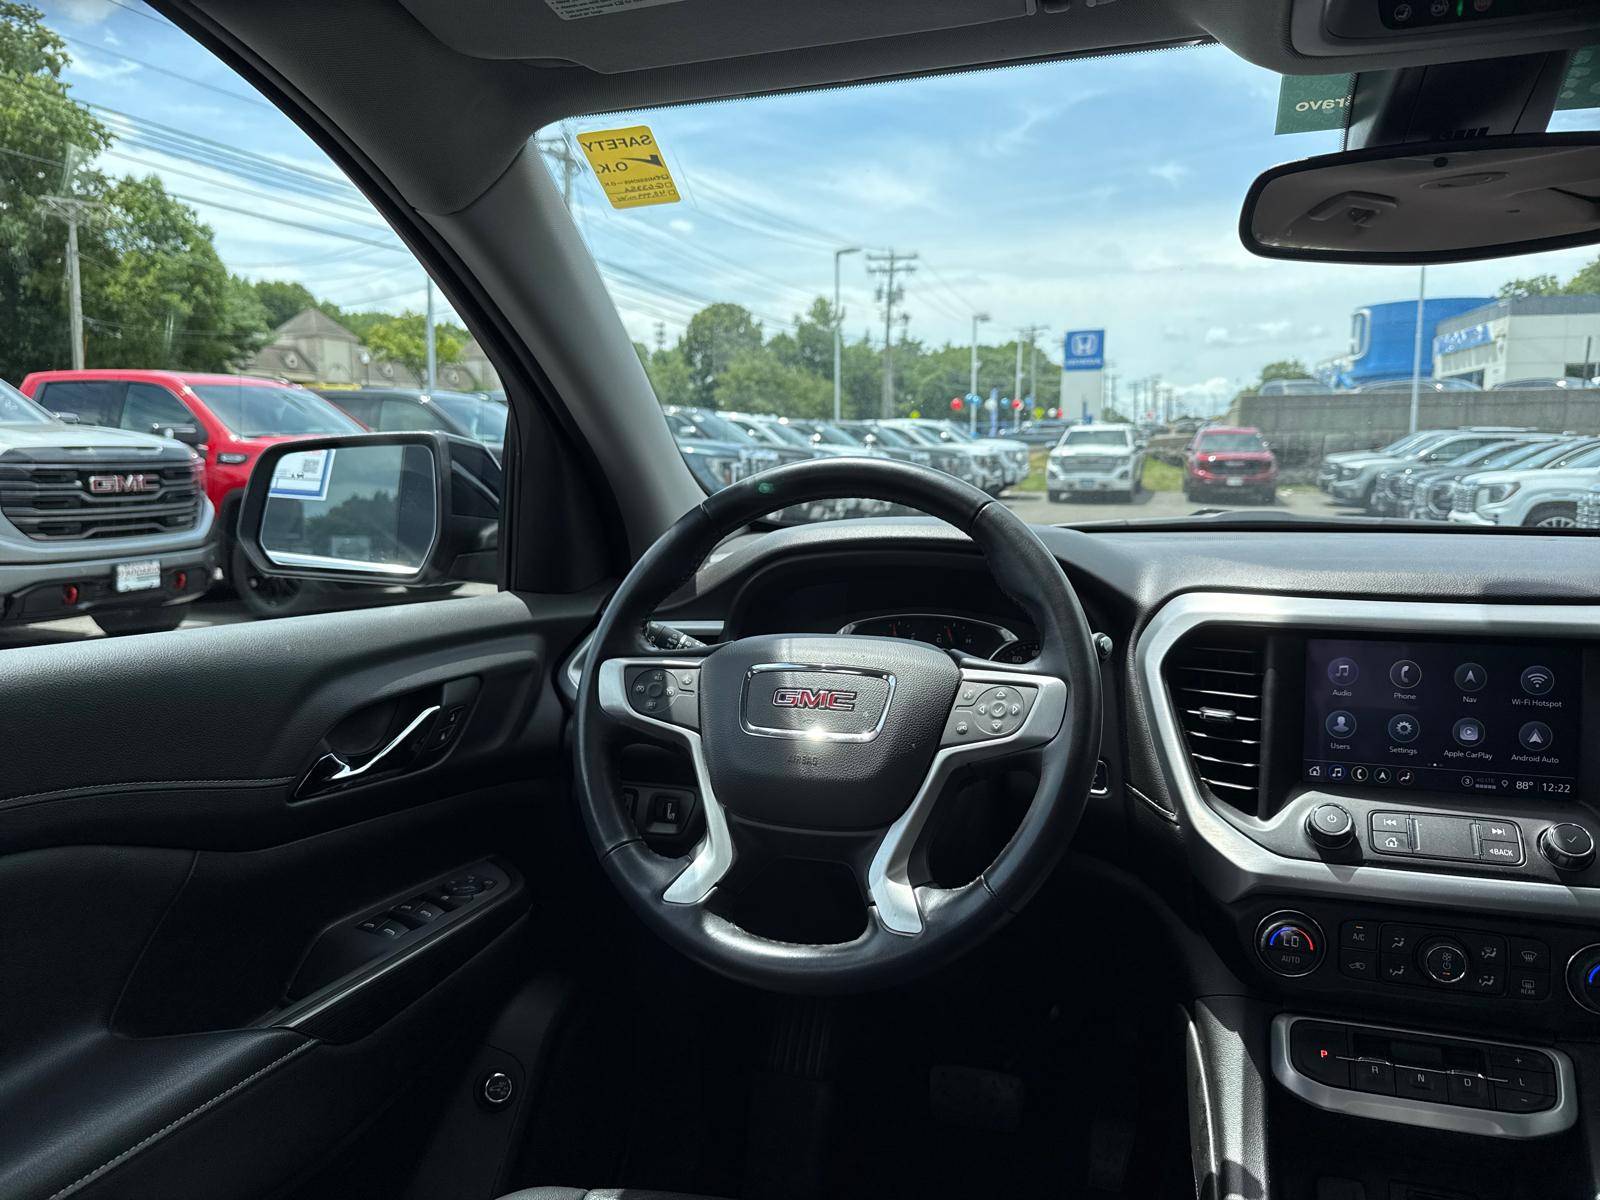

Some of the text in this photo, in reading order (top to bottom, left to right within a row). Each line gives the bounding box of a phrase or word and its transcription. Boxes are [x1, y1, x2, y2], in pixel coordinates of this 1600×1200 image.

[89, 474, 160, 493] GMC
[773, 688, 857, 711] GMC
[1393, 692, 1417, 700] Phone
[1511, 698, 1562, 708] Wi-Fi Hotspot
[1389, 746, 1418, 756] Settings
[1443, 749, 1493, 760] Apple CarPlay
[787, 755, 818, 766] AIRBAG
[1511, 754, 1540, 762] Android
[1542, 783, 1571, 793] 12:22
[1493, 848, 1513, 857] BACK
[1352, 932, 1365, 942] A/C
[1281, 955, 1300, 964] AUTO
[1520, 988, 1536, 996] REAR
[1371, 1066, 1379, 1074] R
[1417, 1074, 1425, 1082] N
[1464, 1078, 1471, 1087] D
[1519, 1078, 1525, 1086] L
